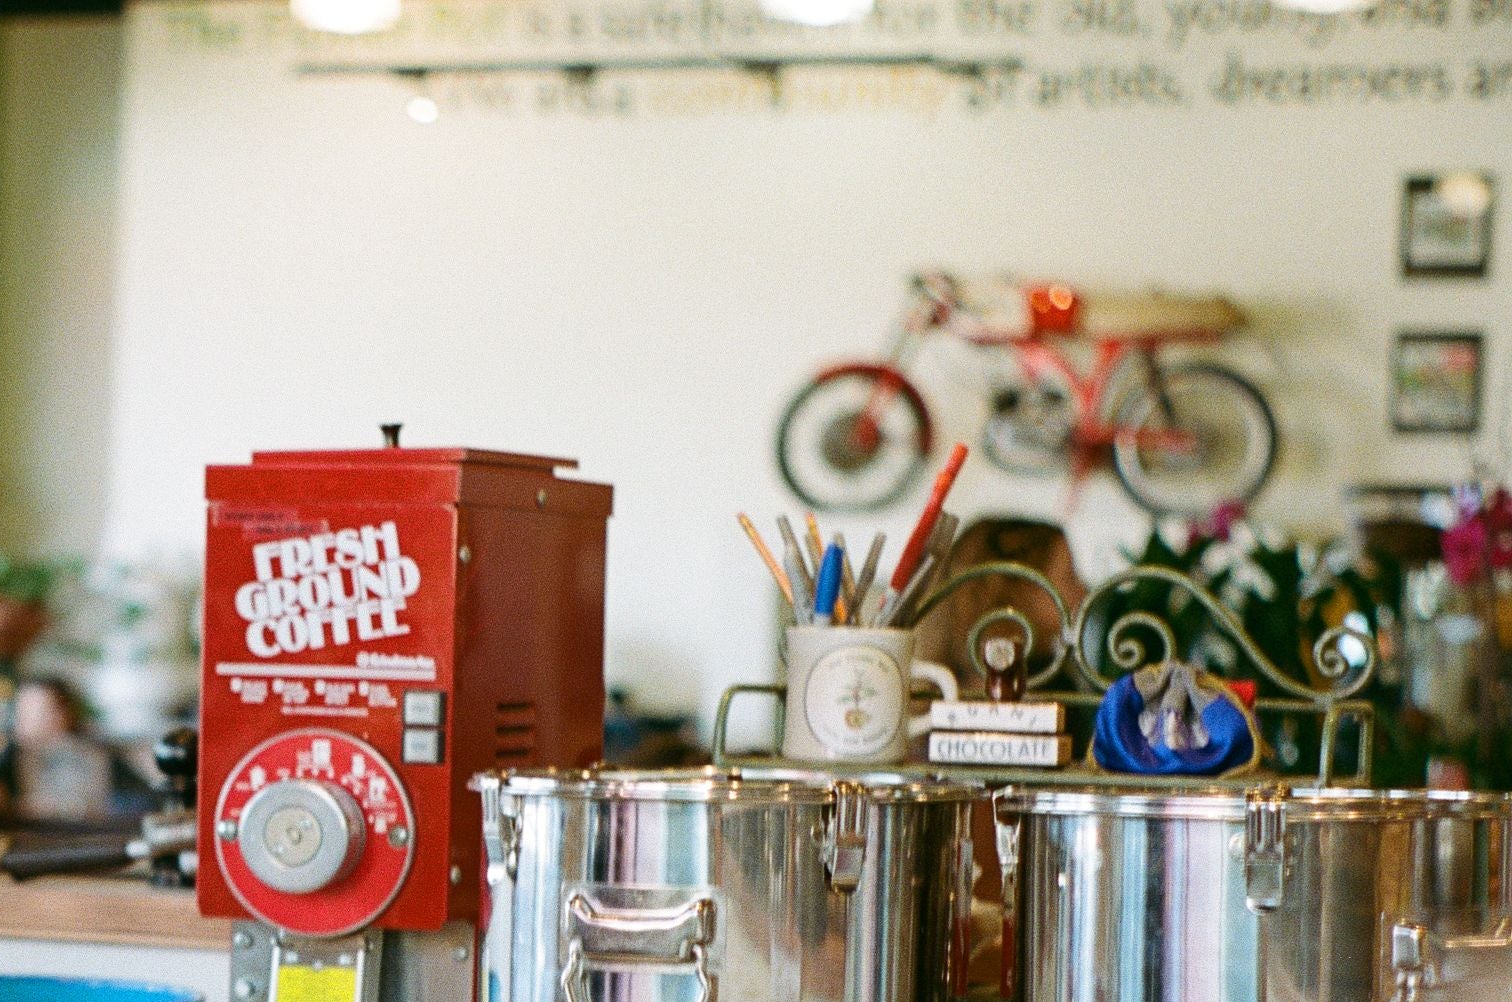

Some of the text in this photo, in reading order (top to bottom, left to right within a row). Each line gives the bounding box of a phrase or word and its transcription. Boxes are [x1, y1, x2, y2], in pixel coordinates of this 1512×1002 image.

[253, 521, 400, 583] FRESH
[234, 556, 421, 622] GROUND
[245, 598, 411, 658] COFFEE
[938, 738, 1050, 761] CHOCOLATE
